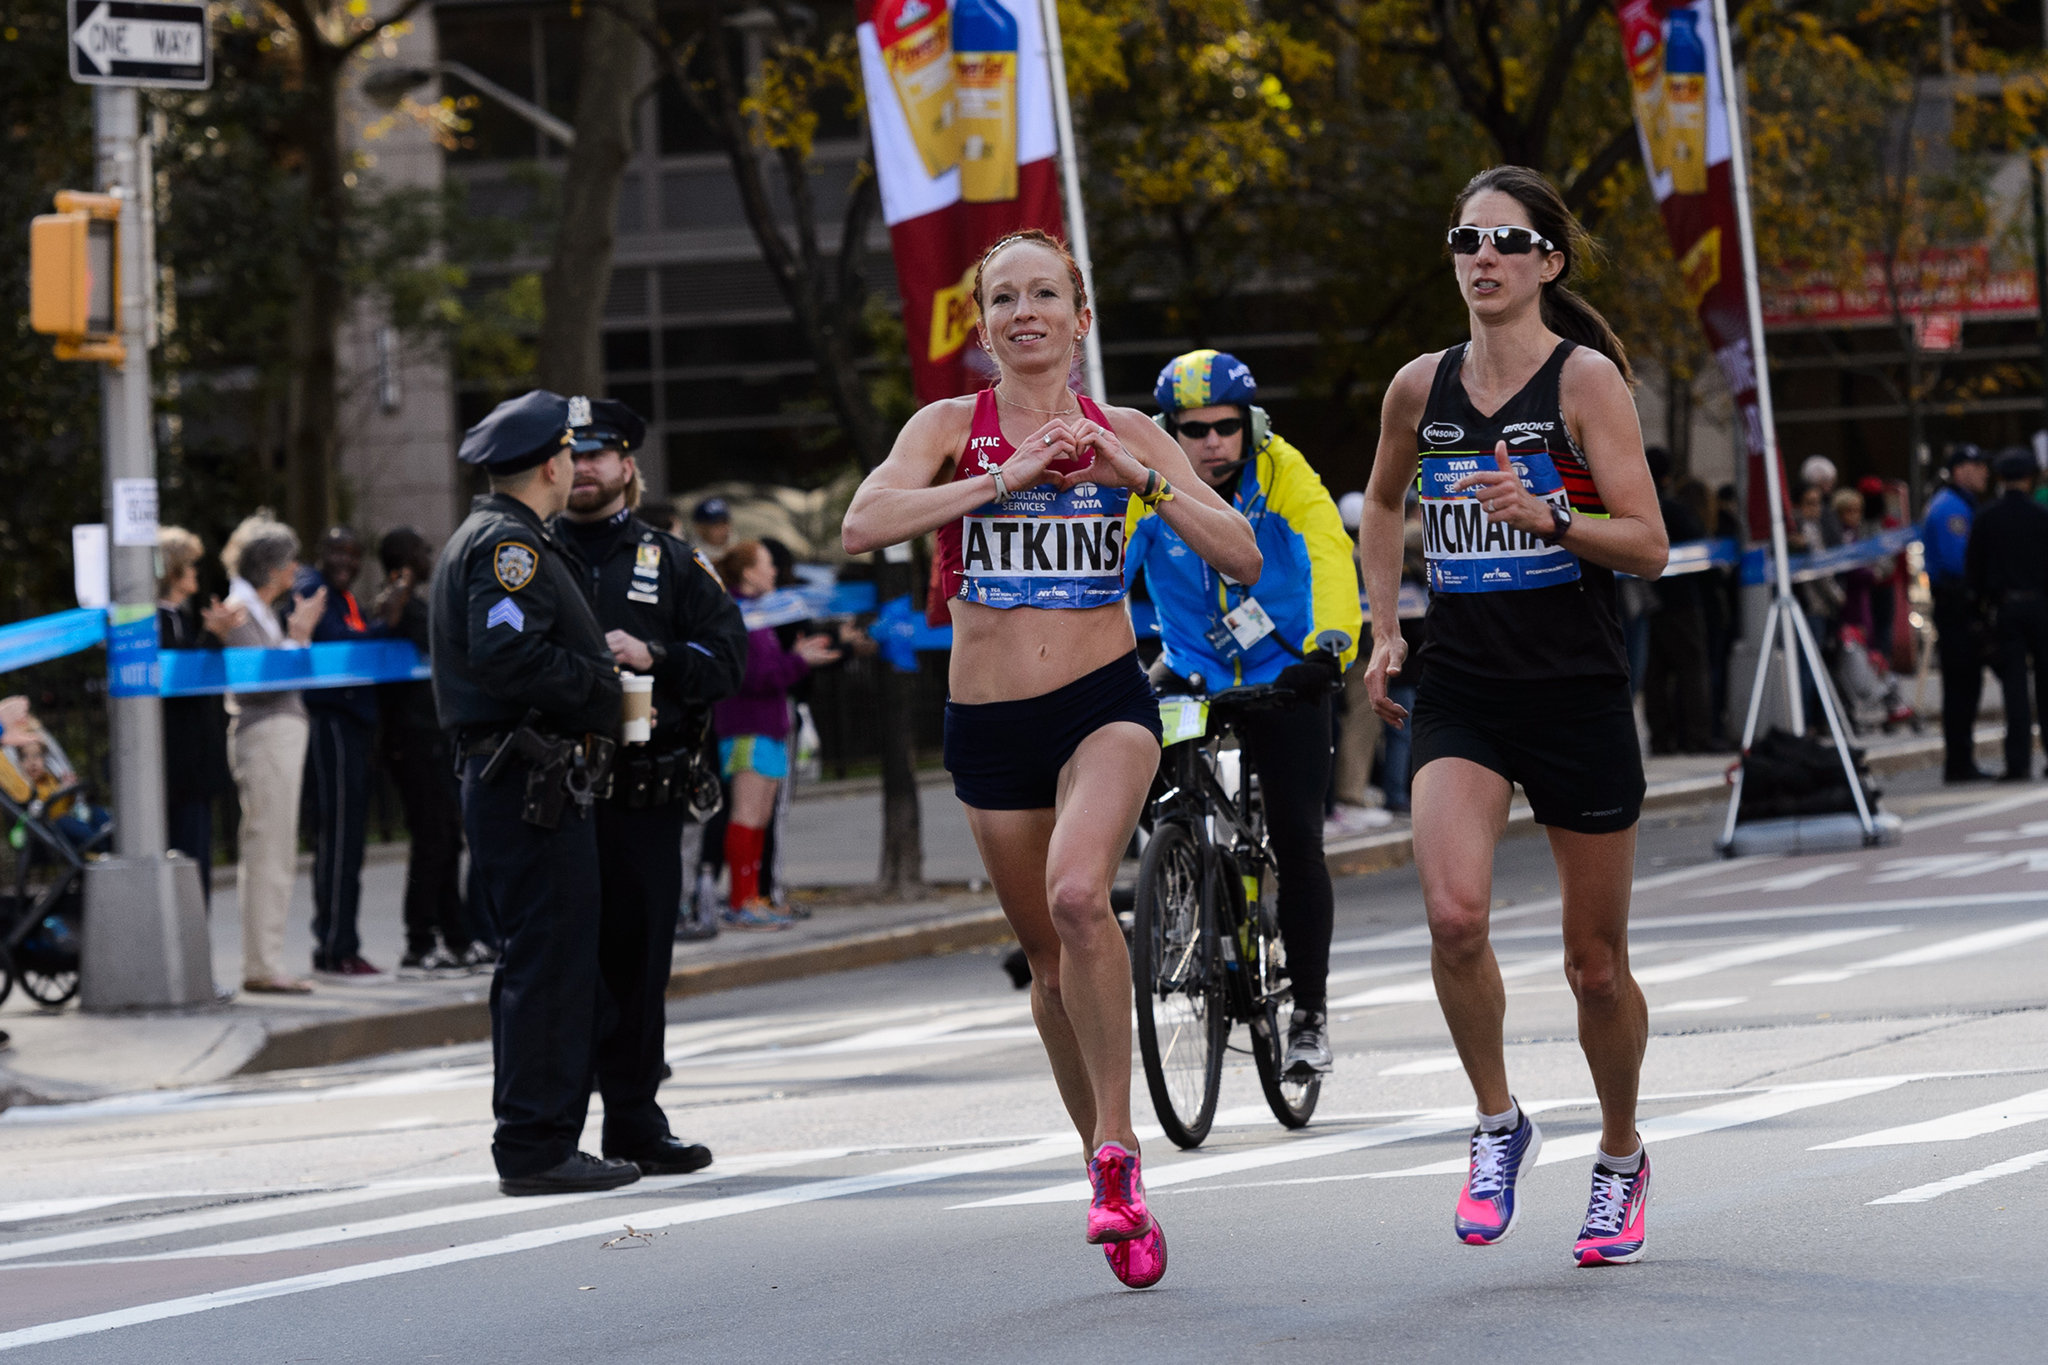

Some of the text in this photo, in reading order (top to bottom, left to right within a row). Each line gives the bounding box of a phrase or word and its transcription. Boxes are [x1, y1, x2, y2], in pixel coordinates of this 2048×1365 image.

[88, 21, 195, 57] ONE WAY
[1502, 421, 1555, 434] BROOKS
[1427, 429, 1459, 438] HANSONS
[971, 436, 1000, 450] NYAC
[1447, 460, 1478, 471] TATA
[1010, 491, 1057, 501] SULTANCY
[1002, 501, 1046, 512] SERVICES
[1071, 499, 1103, 509] TATA
[964, 520, 1122, 571] ATKINS
[1592, 807, 1623, 817] BROOKS
